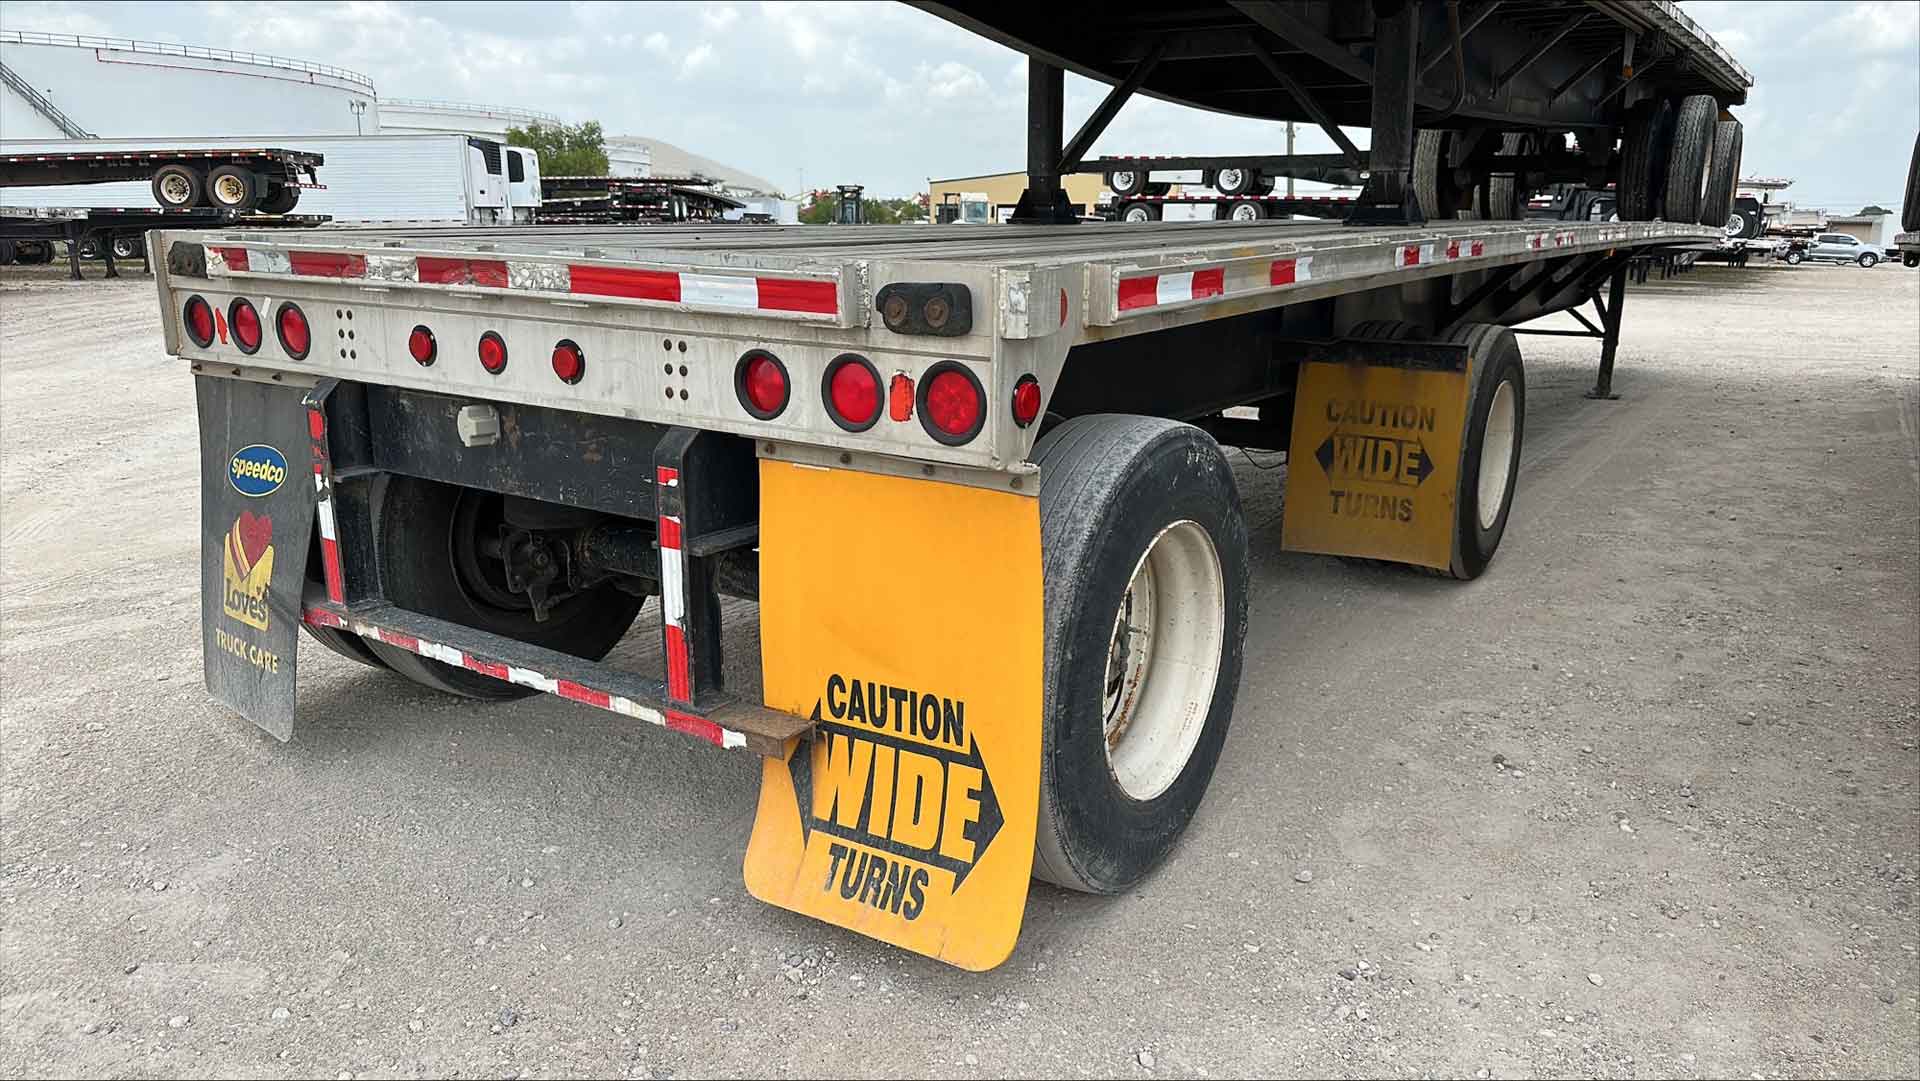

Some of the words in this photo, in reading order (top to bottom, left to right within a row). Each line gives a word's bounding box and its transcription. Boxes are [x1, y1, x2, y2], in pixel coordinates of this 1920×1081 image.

[1326, 399, 1436, 432] CAUTION
[231, 456, 284, 484] speedco
[1333, 437, 1419, 486] WIDE
[1329, 489, 1414, 522] TURNS
[224, 577, 270, 623] Love's
[215, 628, 248, 658] TRUCK
[248, 647, 278, 674] CARE
[826, 673, 965, 747] CAUTION
[812, 732, 983, 865] WIDE
[823, 842, 930, 921] TURNS
